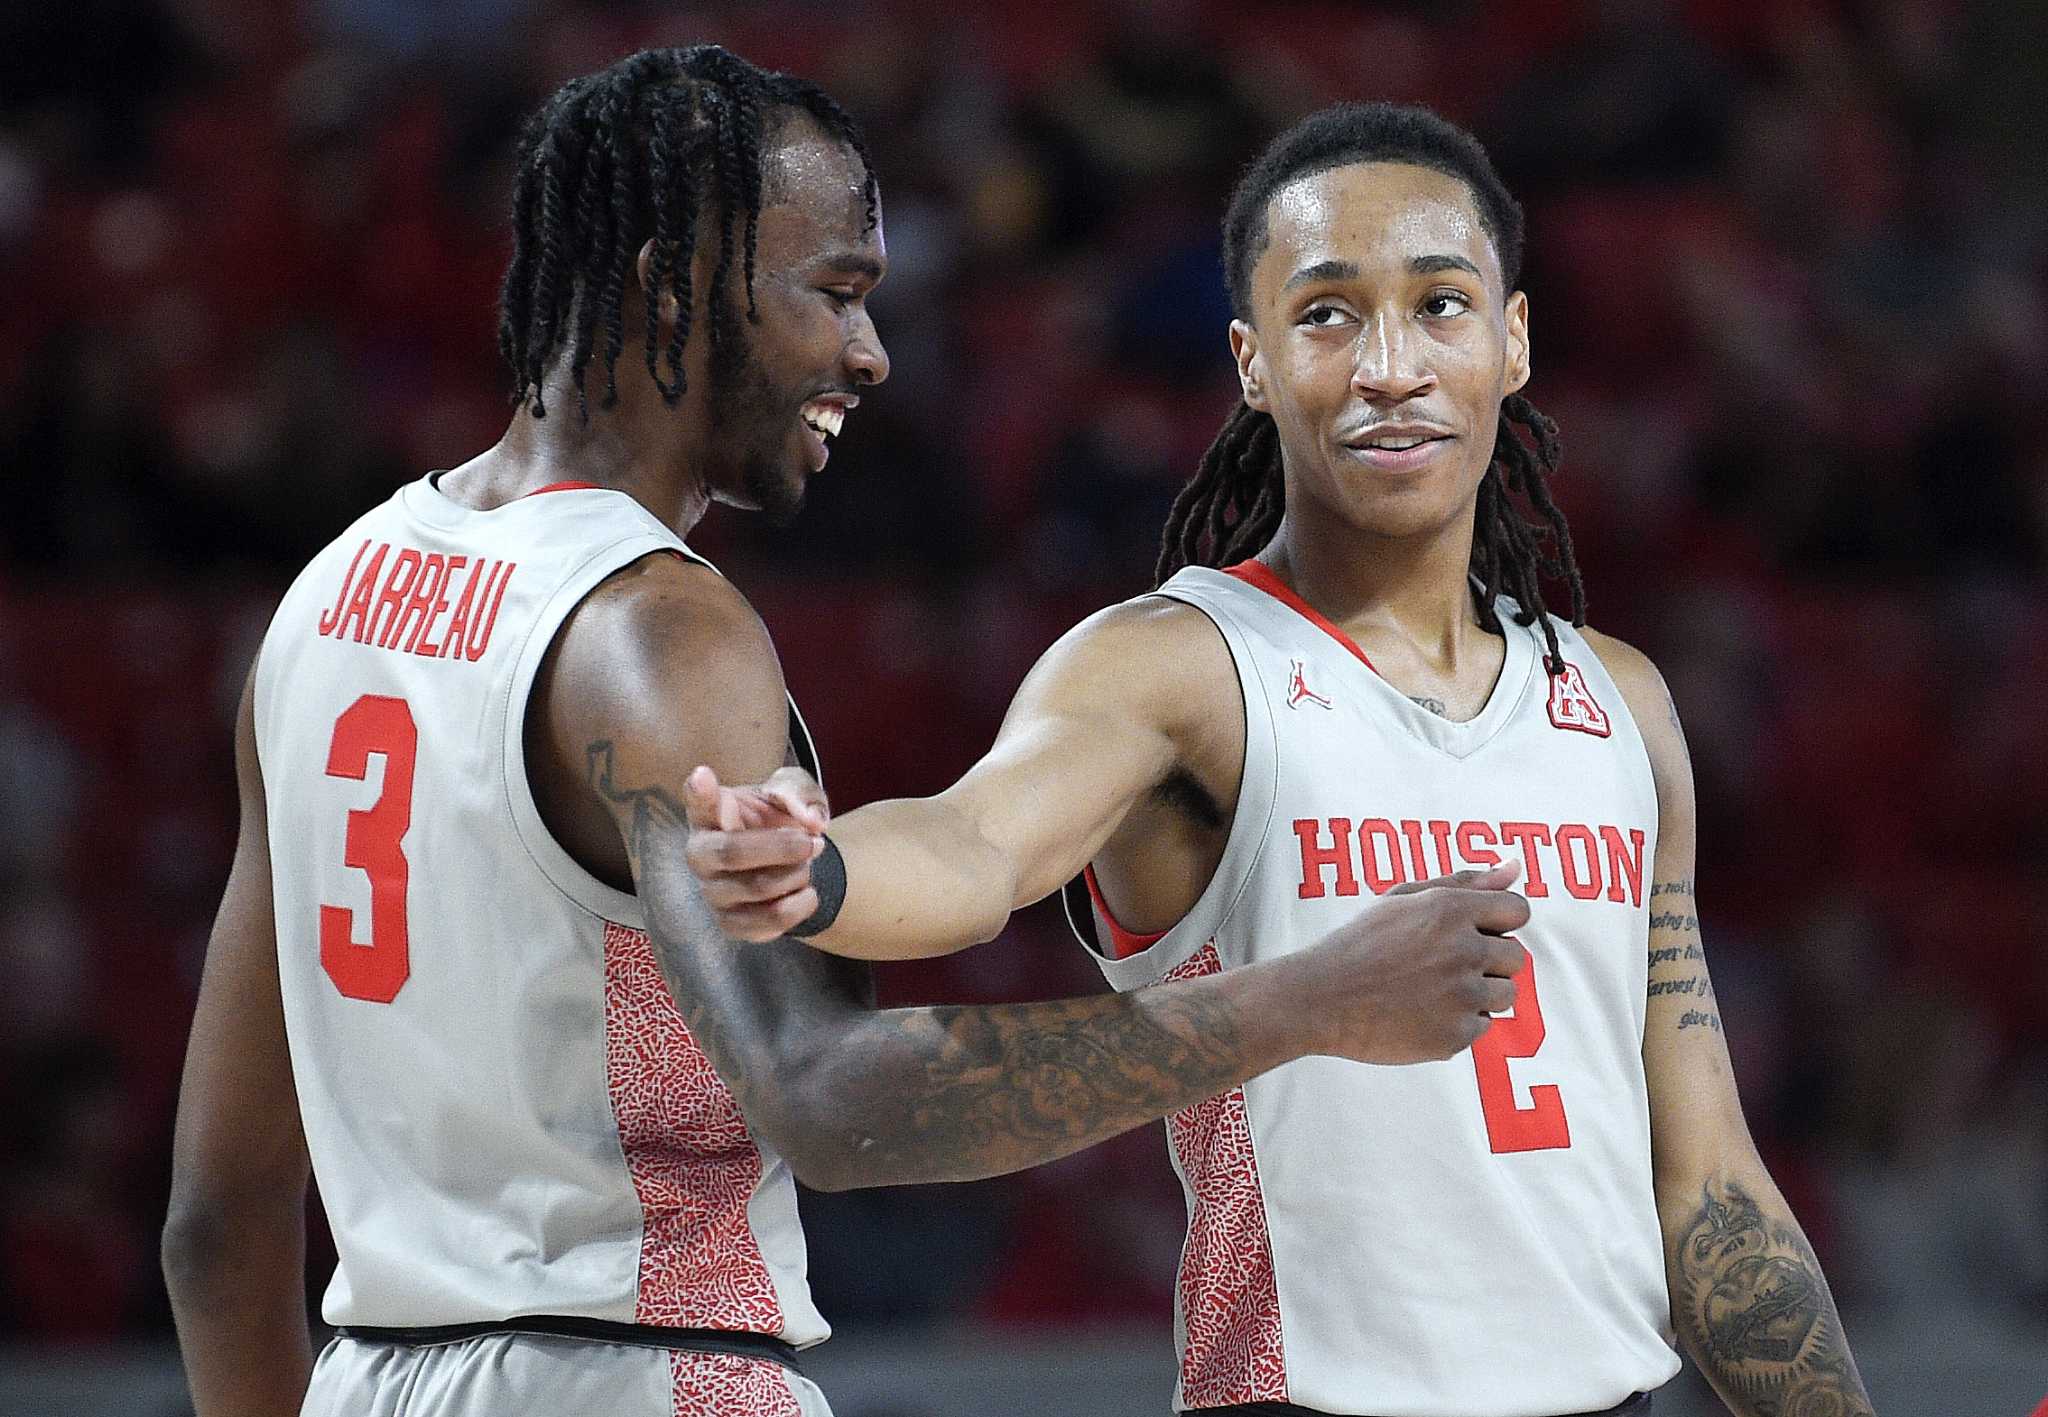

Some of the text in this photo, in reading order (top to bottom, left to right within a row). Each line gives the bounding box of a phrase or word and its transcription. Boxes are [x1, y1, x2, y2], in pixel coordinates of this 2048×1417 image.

[319, 538, 516, 662] JARREAU
[319, 694, 418, 1004] 3
[1293, 818, 1645, 908] HOUSTON
[1470, 936, 1571, 1154] 2
